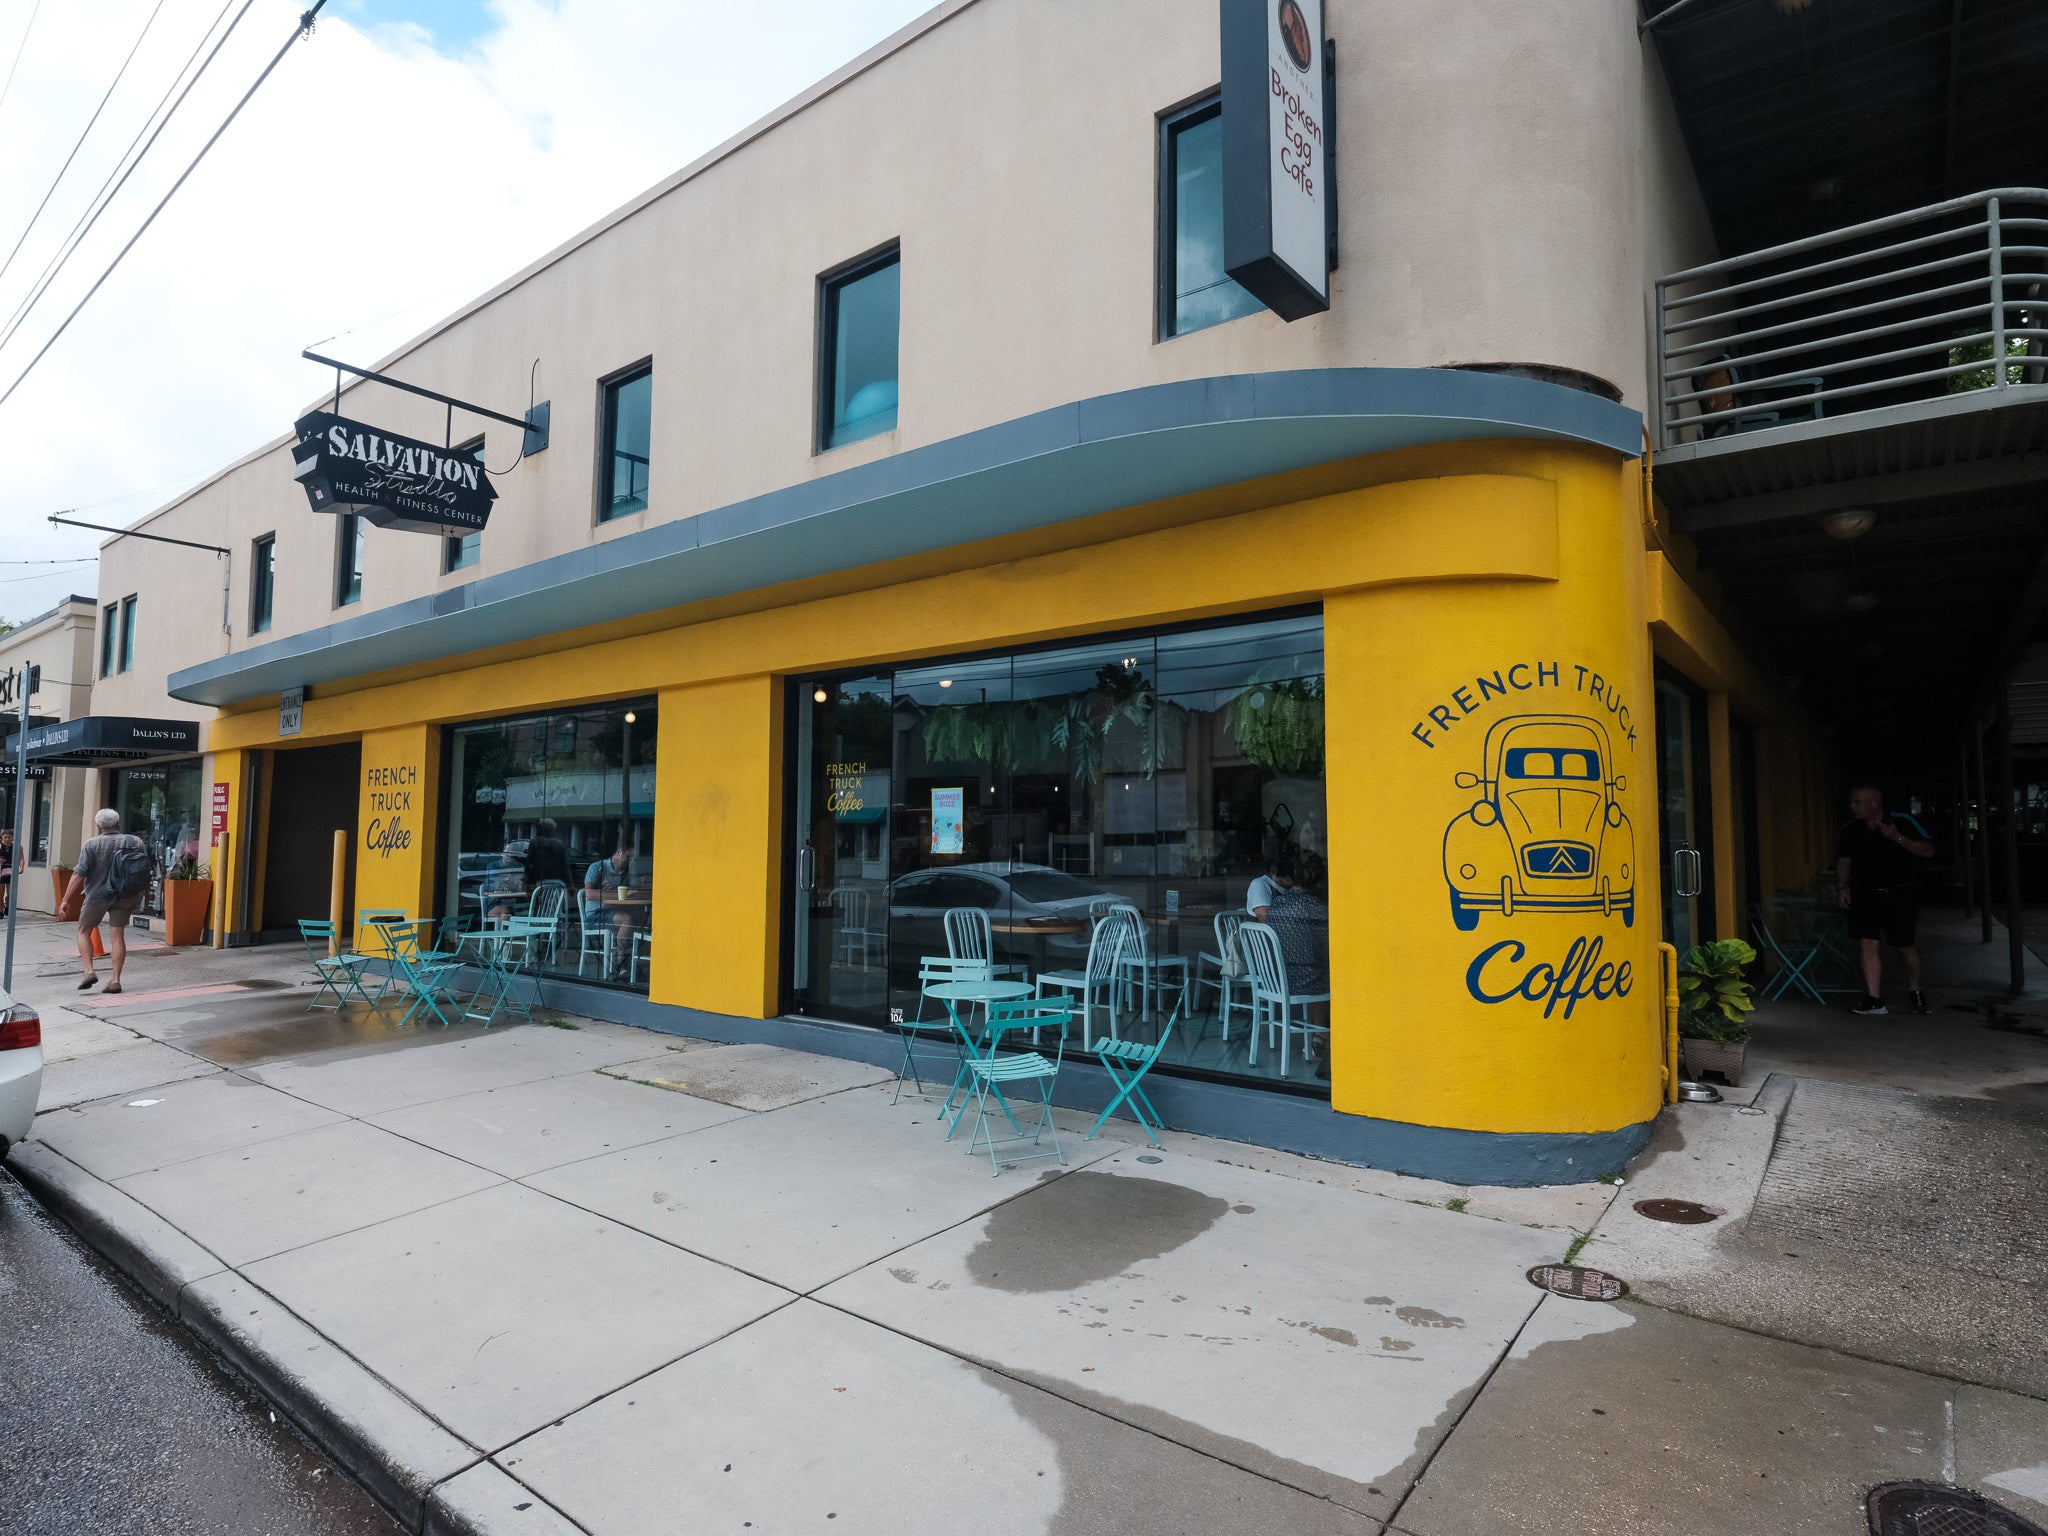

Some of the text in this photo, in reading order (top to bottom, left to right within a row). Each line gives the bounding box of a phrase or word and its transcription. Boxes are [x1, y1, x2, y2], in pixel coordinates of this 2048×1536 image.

[1271, 65, 1322, 147] Broken
[1284, 111, 1312, 167] Egg
[1280, 147, 1313, 197] Cafe
[328, 425, 480, 491] SALVATION
[335, 481, 379, 499] HEALTH
[396, 496, 439, 514] FITNESS
[444, 508, 482, 525] CENTER
[282, 711, 299, 729] ONLY
[1411, 661, 1638, 753] FRENCH TRUCK
[368, 765, 417, 787] FRENCH
[826, 762, 866, 776] FRENCH
[829, 776, 862, 790] TRUCK
[371, 791, 411, 811] TRUCK
[827, 791, 864, 816] Coffee
[934, 793, 960, 801] SUMMER
[366, 816, 412, 859] Coffee
[1466, 935, 1634, 1020] Coffee
[890, 1013, 904, 1024] 104
